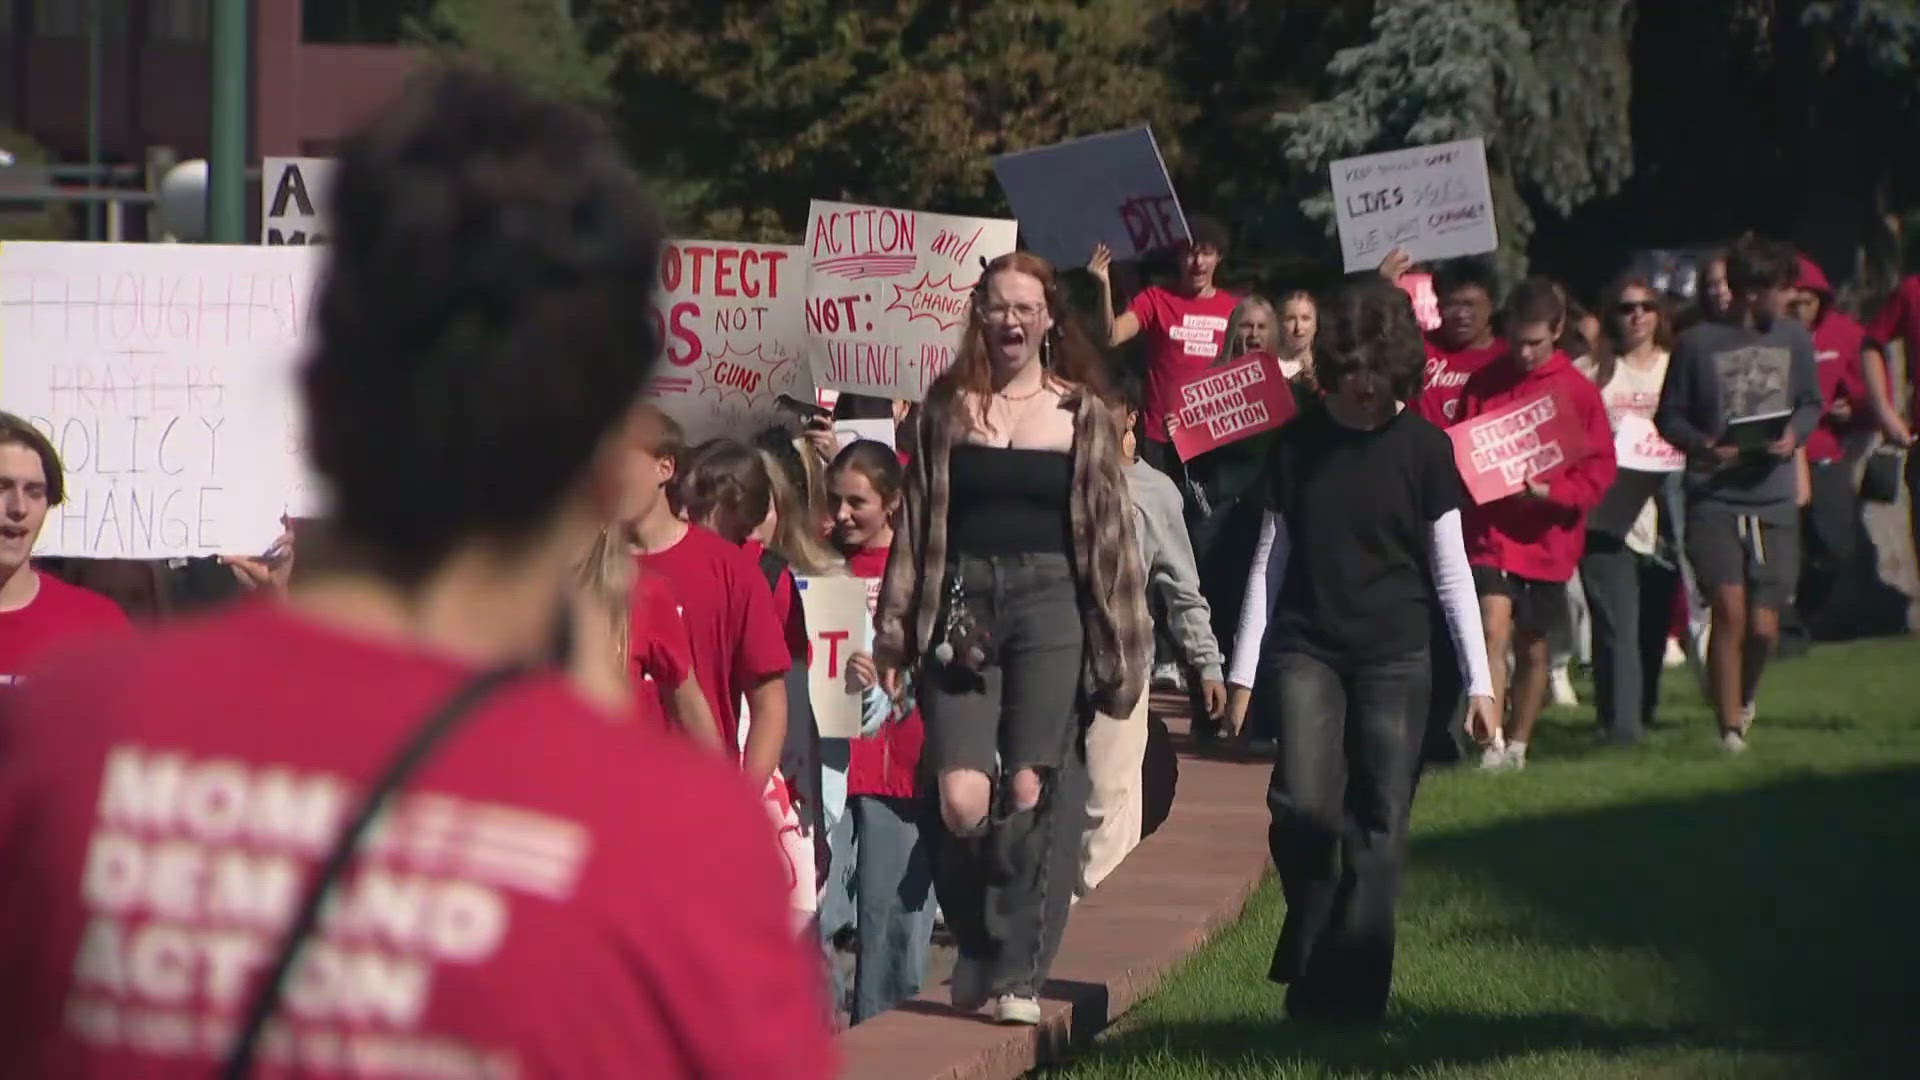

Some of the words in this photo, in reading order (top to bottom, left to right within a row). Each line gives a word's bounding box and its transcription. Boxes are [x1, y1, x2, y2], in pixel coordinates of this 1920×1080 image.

[269, 163, 315, 217] A
[1346, 186, 1404, 219] LIVES
[813, 209, 916, 257] ACTION
[930, 226, 985, 267] and
[661, 245, 788, 298] OTECT
[714, 307, 769, 335] NOT
[805, 293, 874, 335] NOT:
[714, 361, 762, 394] GUNS
[825, 340, 904, 387] SILENCE
[1183, 362, 1264, 405] STUDENTS
[48, 362, 225, 413] PRAYERS
[1181, 390, 1245, 427] DEMAND
[1210, 402, 1268, 438] ACTION
[1473, 398, 1554, 446] STUDENTS
[1473, 431, 1539, 471] DEMAND
[32, 484, 225, 553] HANGE
